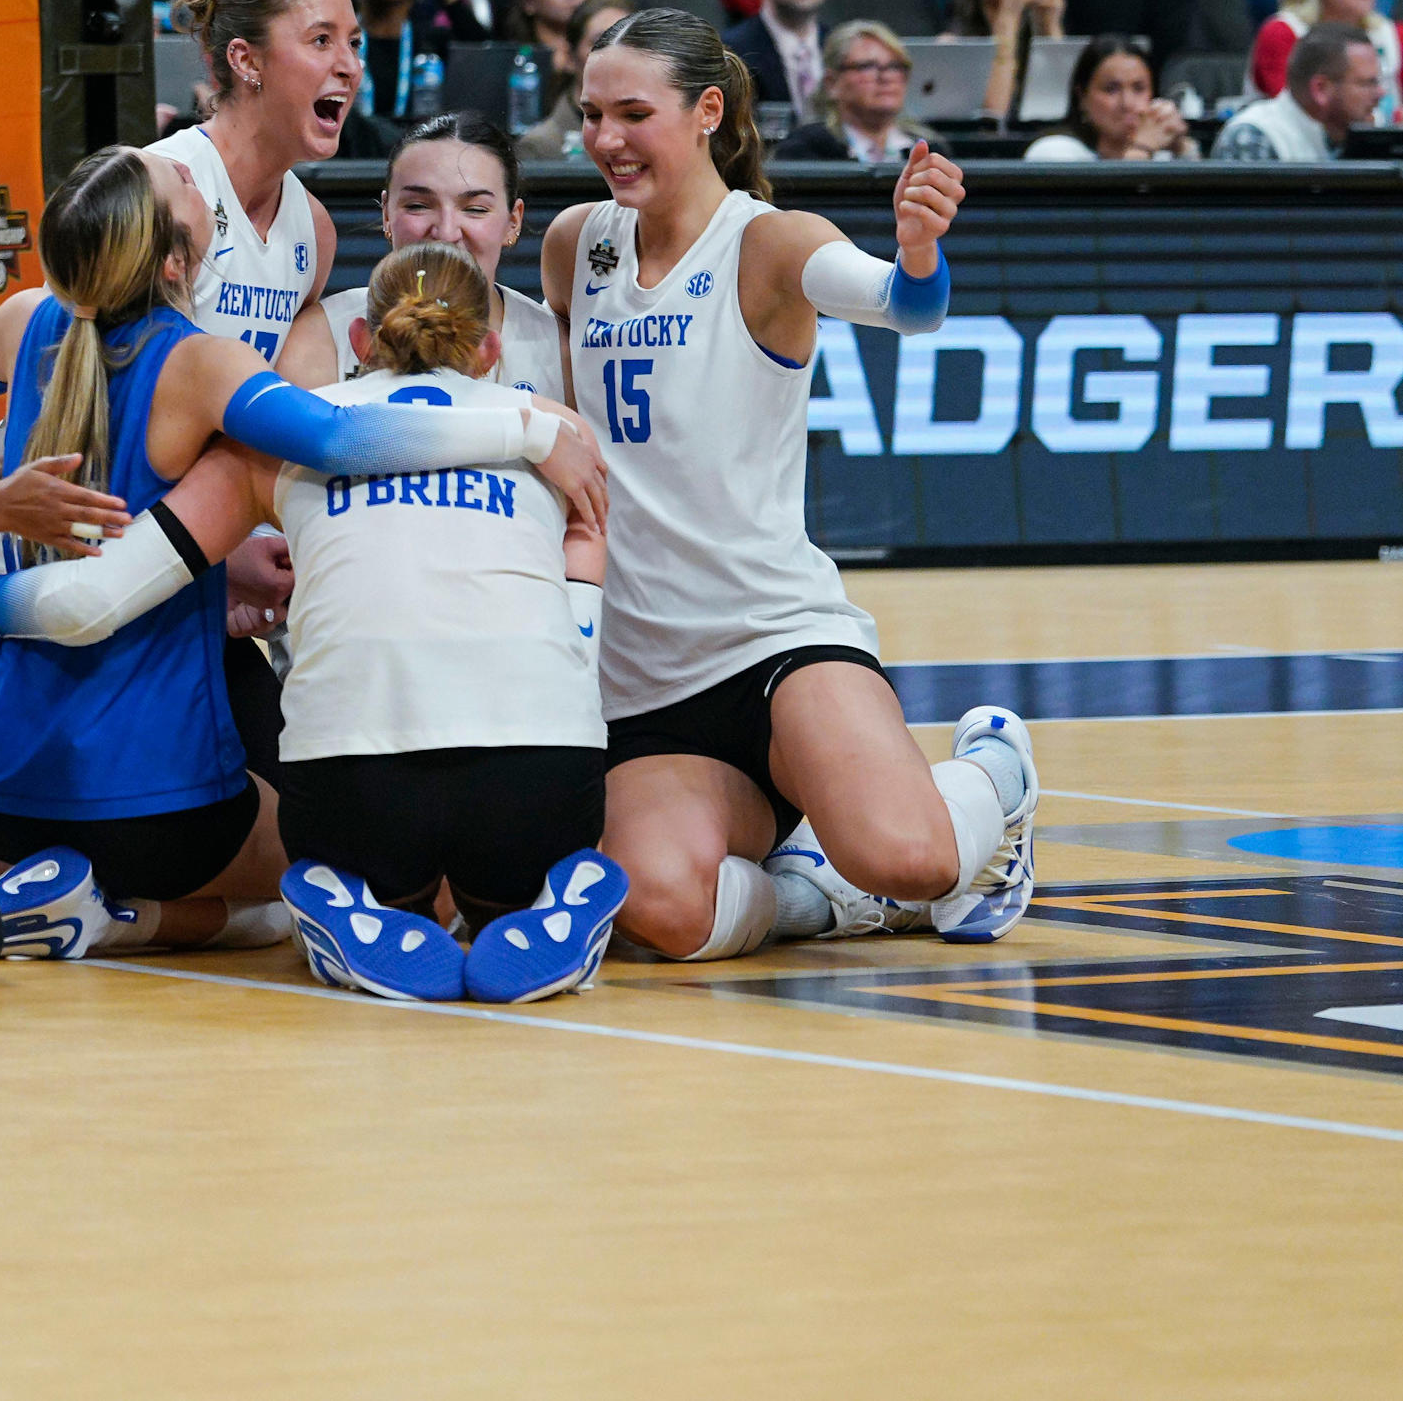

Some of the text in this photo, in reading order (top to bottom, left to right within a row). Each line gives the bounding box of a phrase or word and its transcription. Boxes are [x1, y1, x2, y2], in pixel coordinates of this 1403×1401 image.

[686, 271, 712, 297] SEC
[603, 359, 654, 443] 15
[808, 312, 1403, 456] ADGER
[326, 467, 517, 519] O'BRIEN
